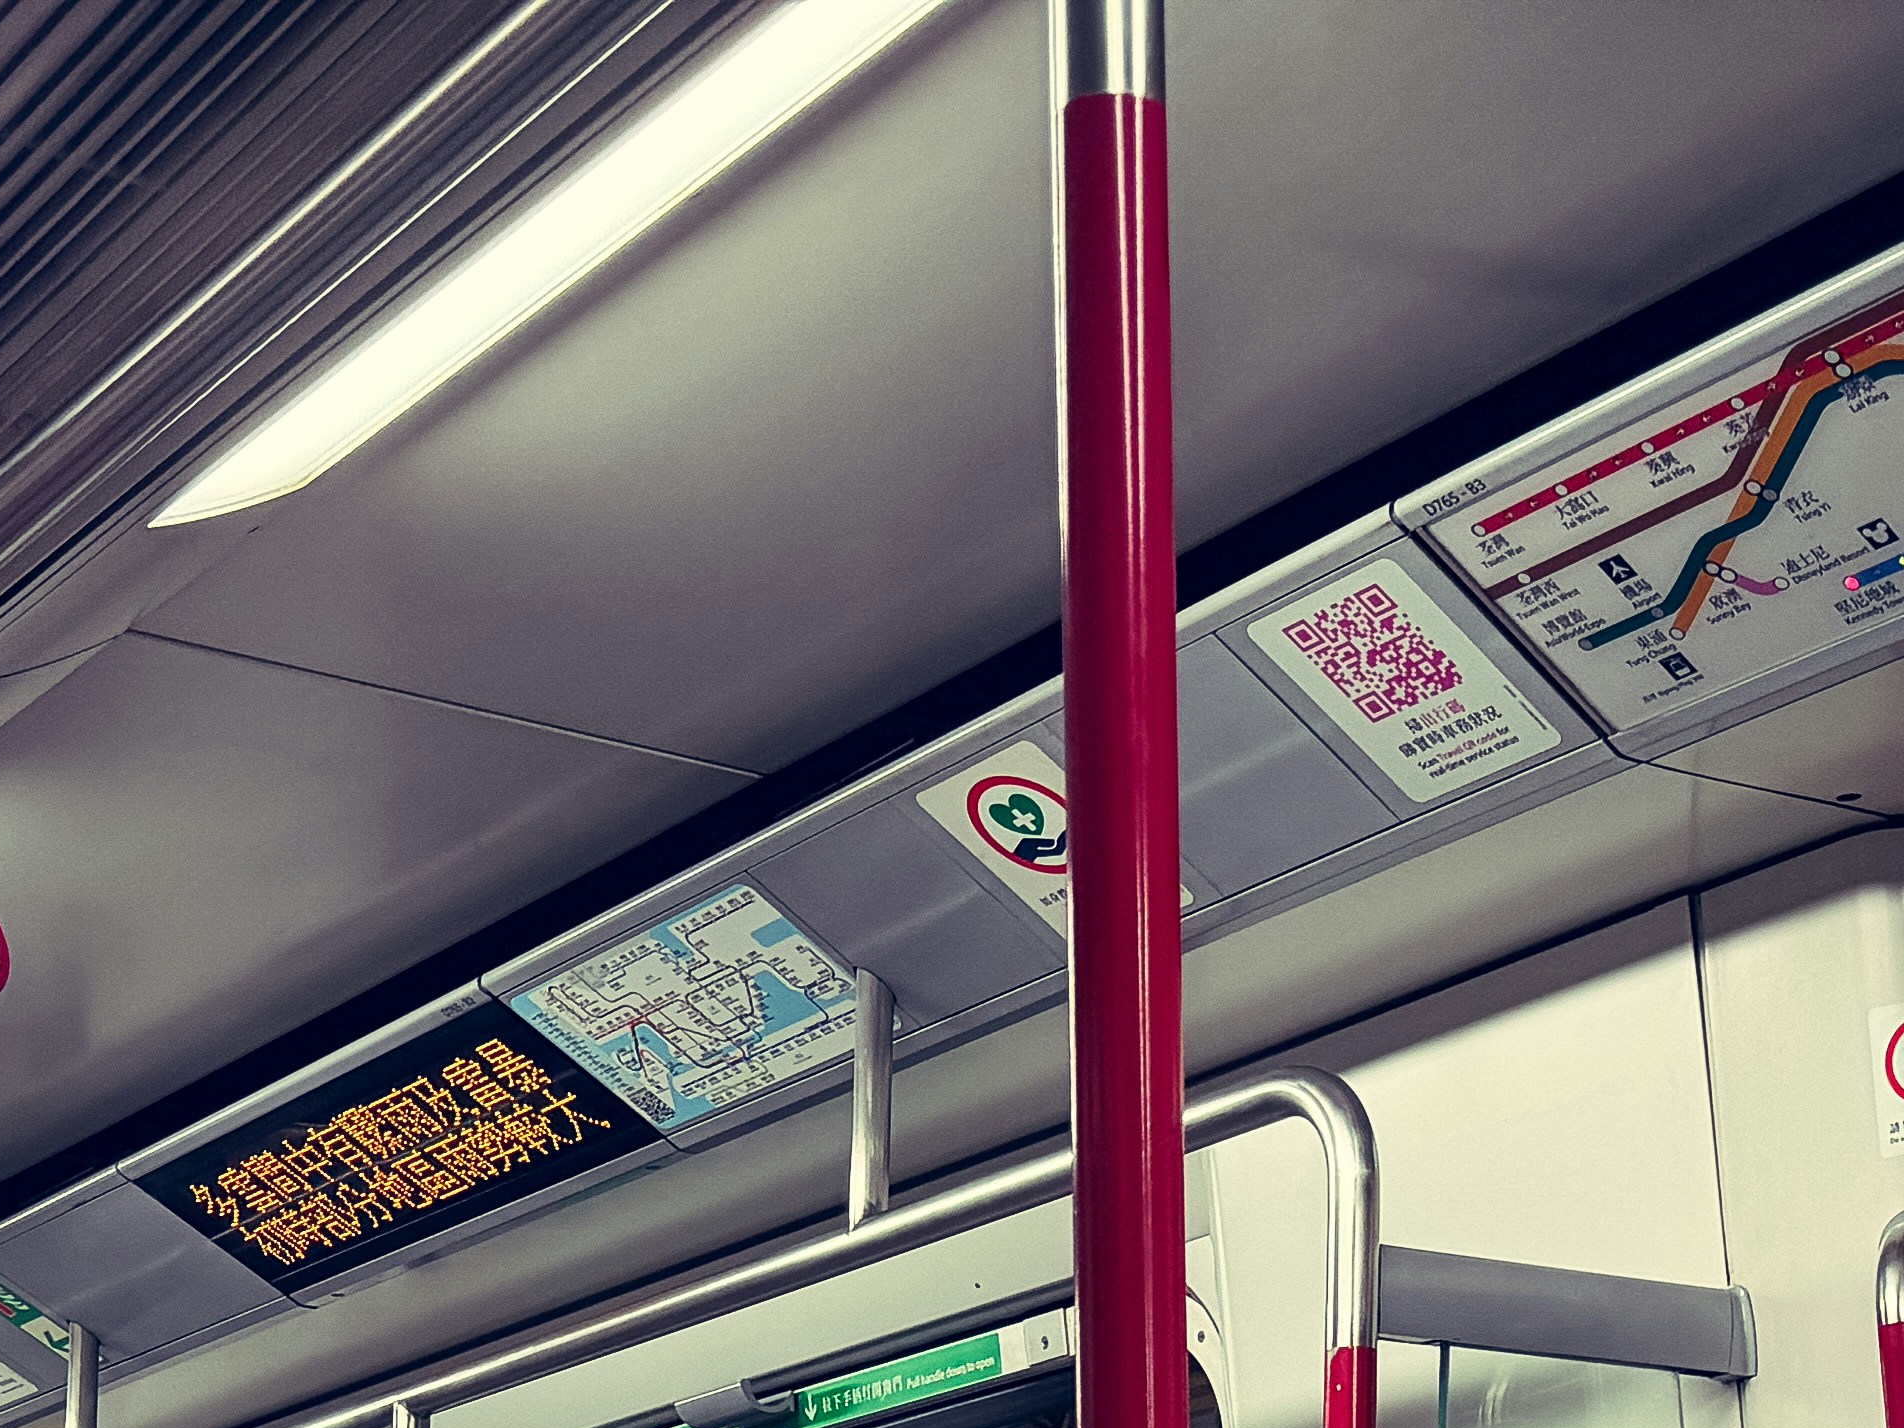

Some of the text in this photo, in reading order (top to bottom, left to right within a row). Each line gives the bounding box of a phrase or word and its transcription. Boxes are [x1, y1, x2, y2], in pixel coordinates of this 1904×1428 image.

[189, 1039, 552, 1227] 多雲間中有驟雨及雷暴
[244, 1090, 610, 1265] 初時部分地區雨勢較大
